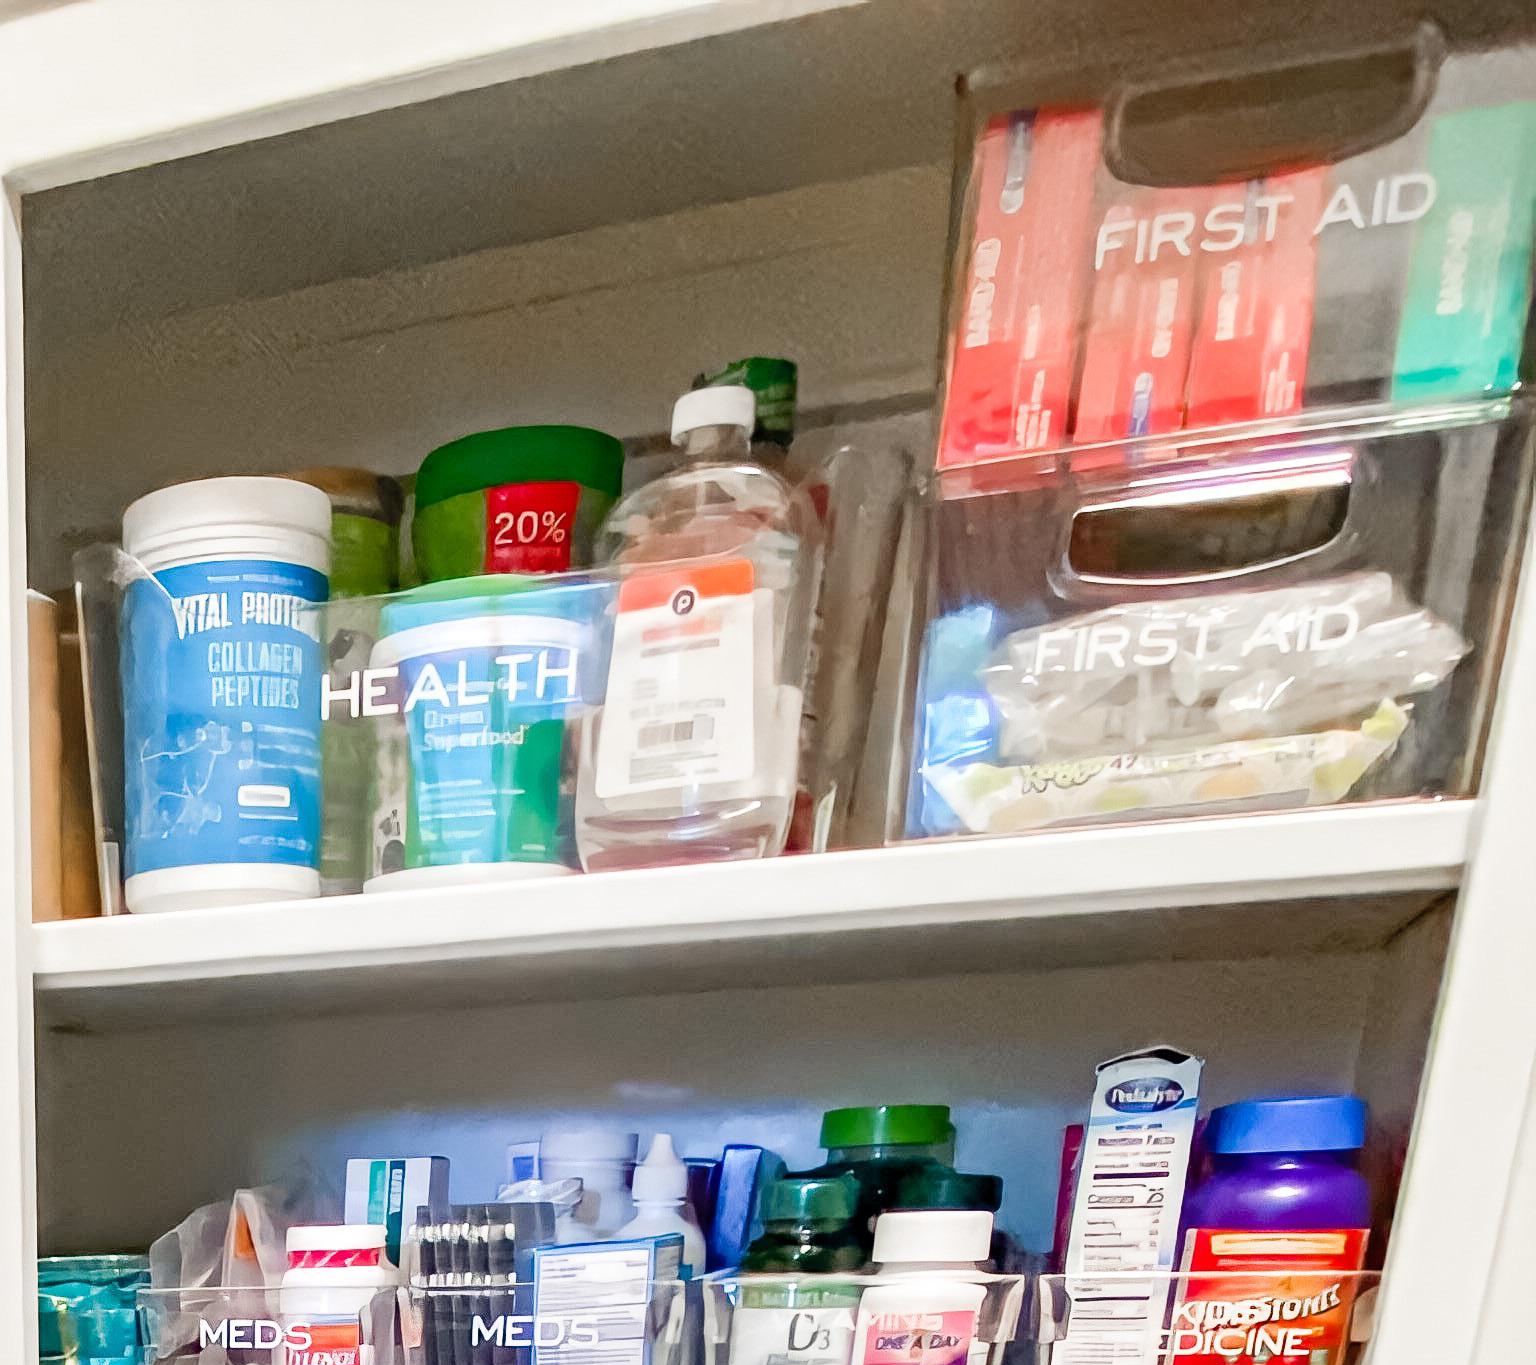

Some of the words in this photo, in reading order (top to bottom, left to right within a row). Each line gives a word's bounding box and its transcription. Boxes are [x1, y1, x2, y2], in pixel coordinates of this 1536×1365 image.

[1095, 194, 1295, 271] FIRST
[1313, 173, 1438, 238] AID
[494, 510, 567, 546] 20%
[173, 592, 233, 640] VITAL
[208, 641, 303, 675] COLLAGEN
[1034, 620, 1214, 677] FIRST
[1241, 605, 1360, 658] AID
[211, 675, 300, 709] PEPTIDES
[321, 650, 579, 721] HEALTH
[199, 1318, 313, 1352] MEDS
[471, 1314, 600, 1348] MEDS
